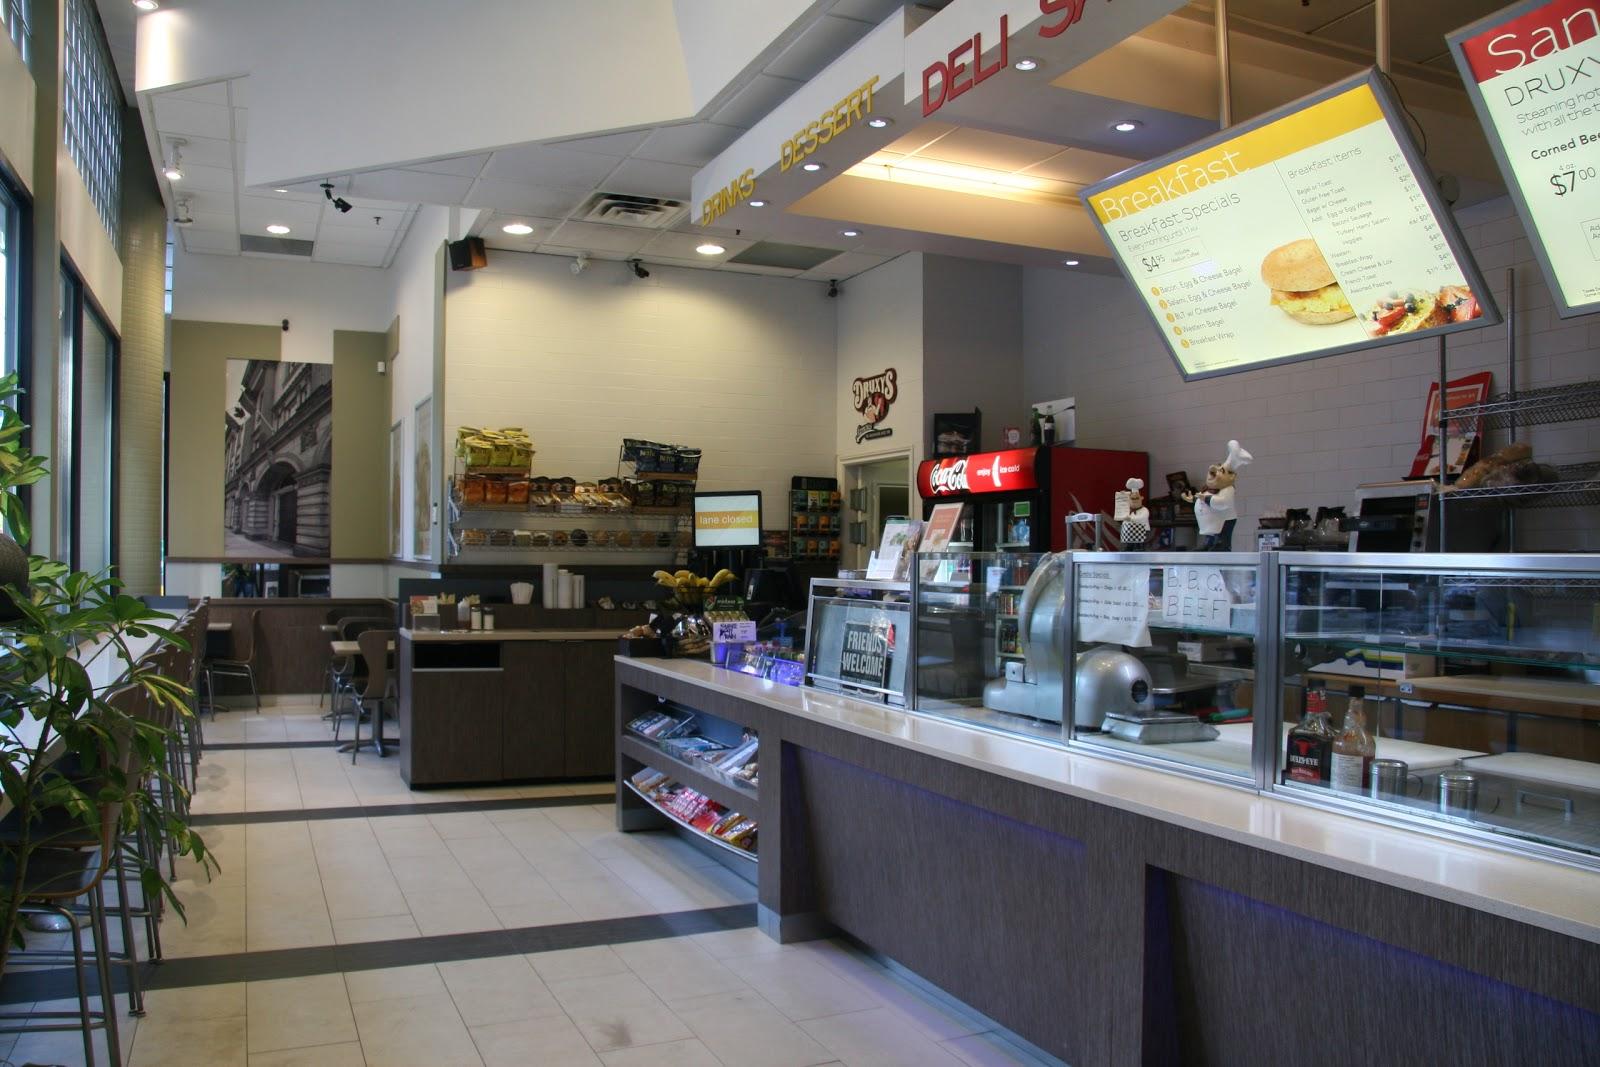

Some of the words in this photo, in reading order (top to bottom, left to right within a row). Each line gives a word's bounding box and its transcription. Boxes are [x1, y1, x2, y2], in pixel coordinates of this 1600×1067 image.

[922, 14, 1008, 118] DELI
[1039, 0, 1086, 38] S
[780, 75, 880, 172] DESSERT
[1516, 97, 1576, 124] Steaming
[1521, 120, 1552, 136] with
[1554, 114, 1566, 127] all
[1567, 107, 1592, 121] the
[1531, 138, 1576, 160] Corned
[1288, 158, 1334, 179] Breakfast
[702, 167, 756, 227] DRINKS
[1100, 150, 1250, 221] Breakfast
[1119, 213, 1183, 242] Breakfast
[1181, 192, 1241, 221] Specials
[1007, 464, 1020, 473] cold
[700, 516, 720, 524] lane
[721, 514, 754, 525] closed
[1167, 595, 1228, 620] BEEF
[847, 630, 882, 654] FRIENDS
[842, 652, 883, 677] WELCOME
